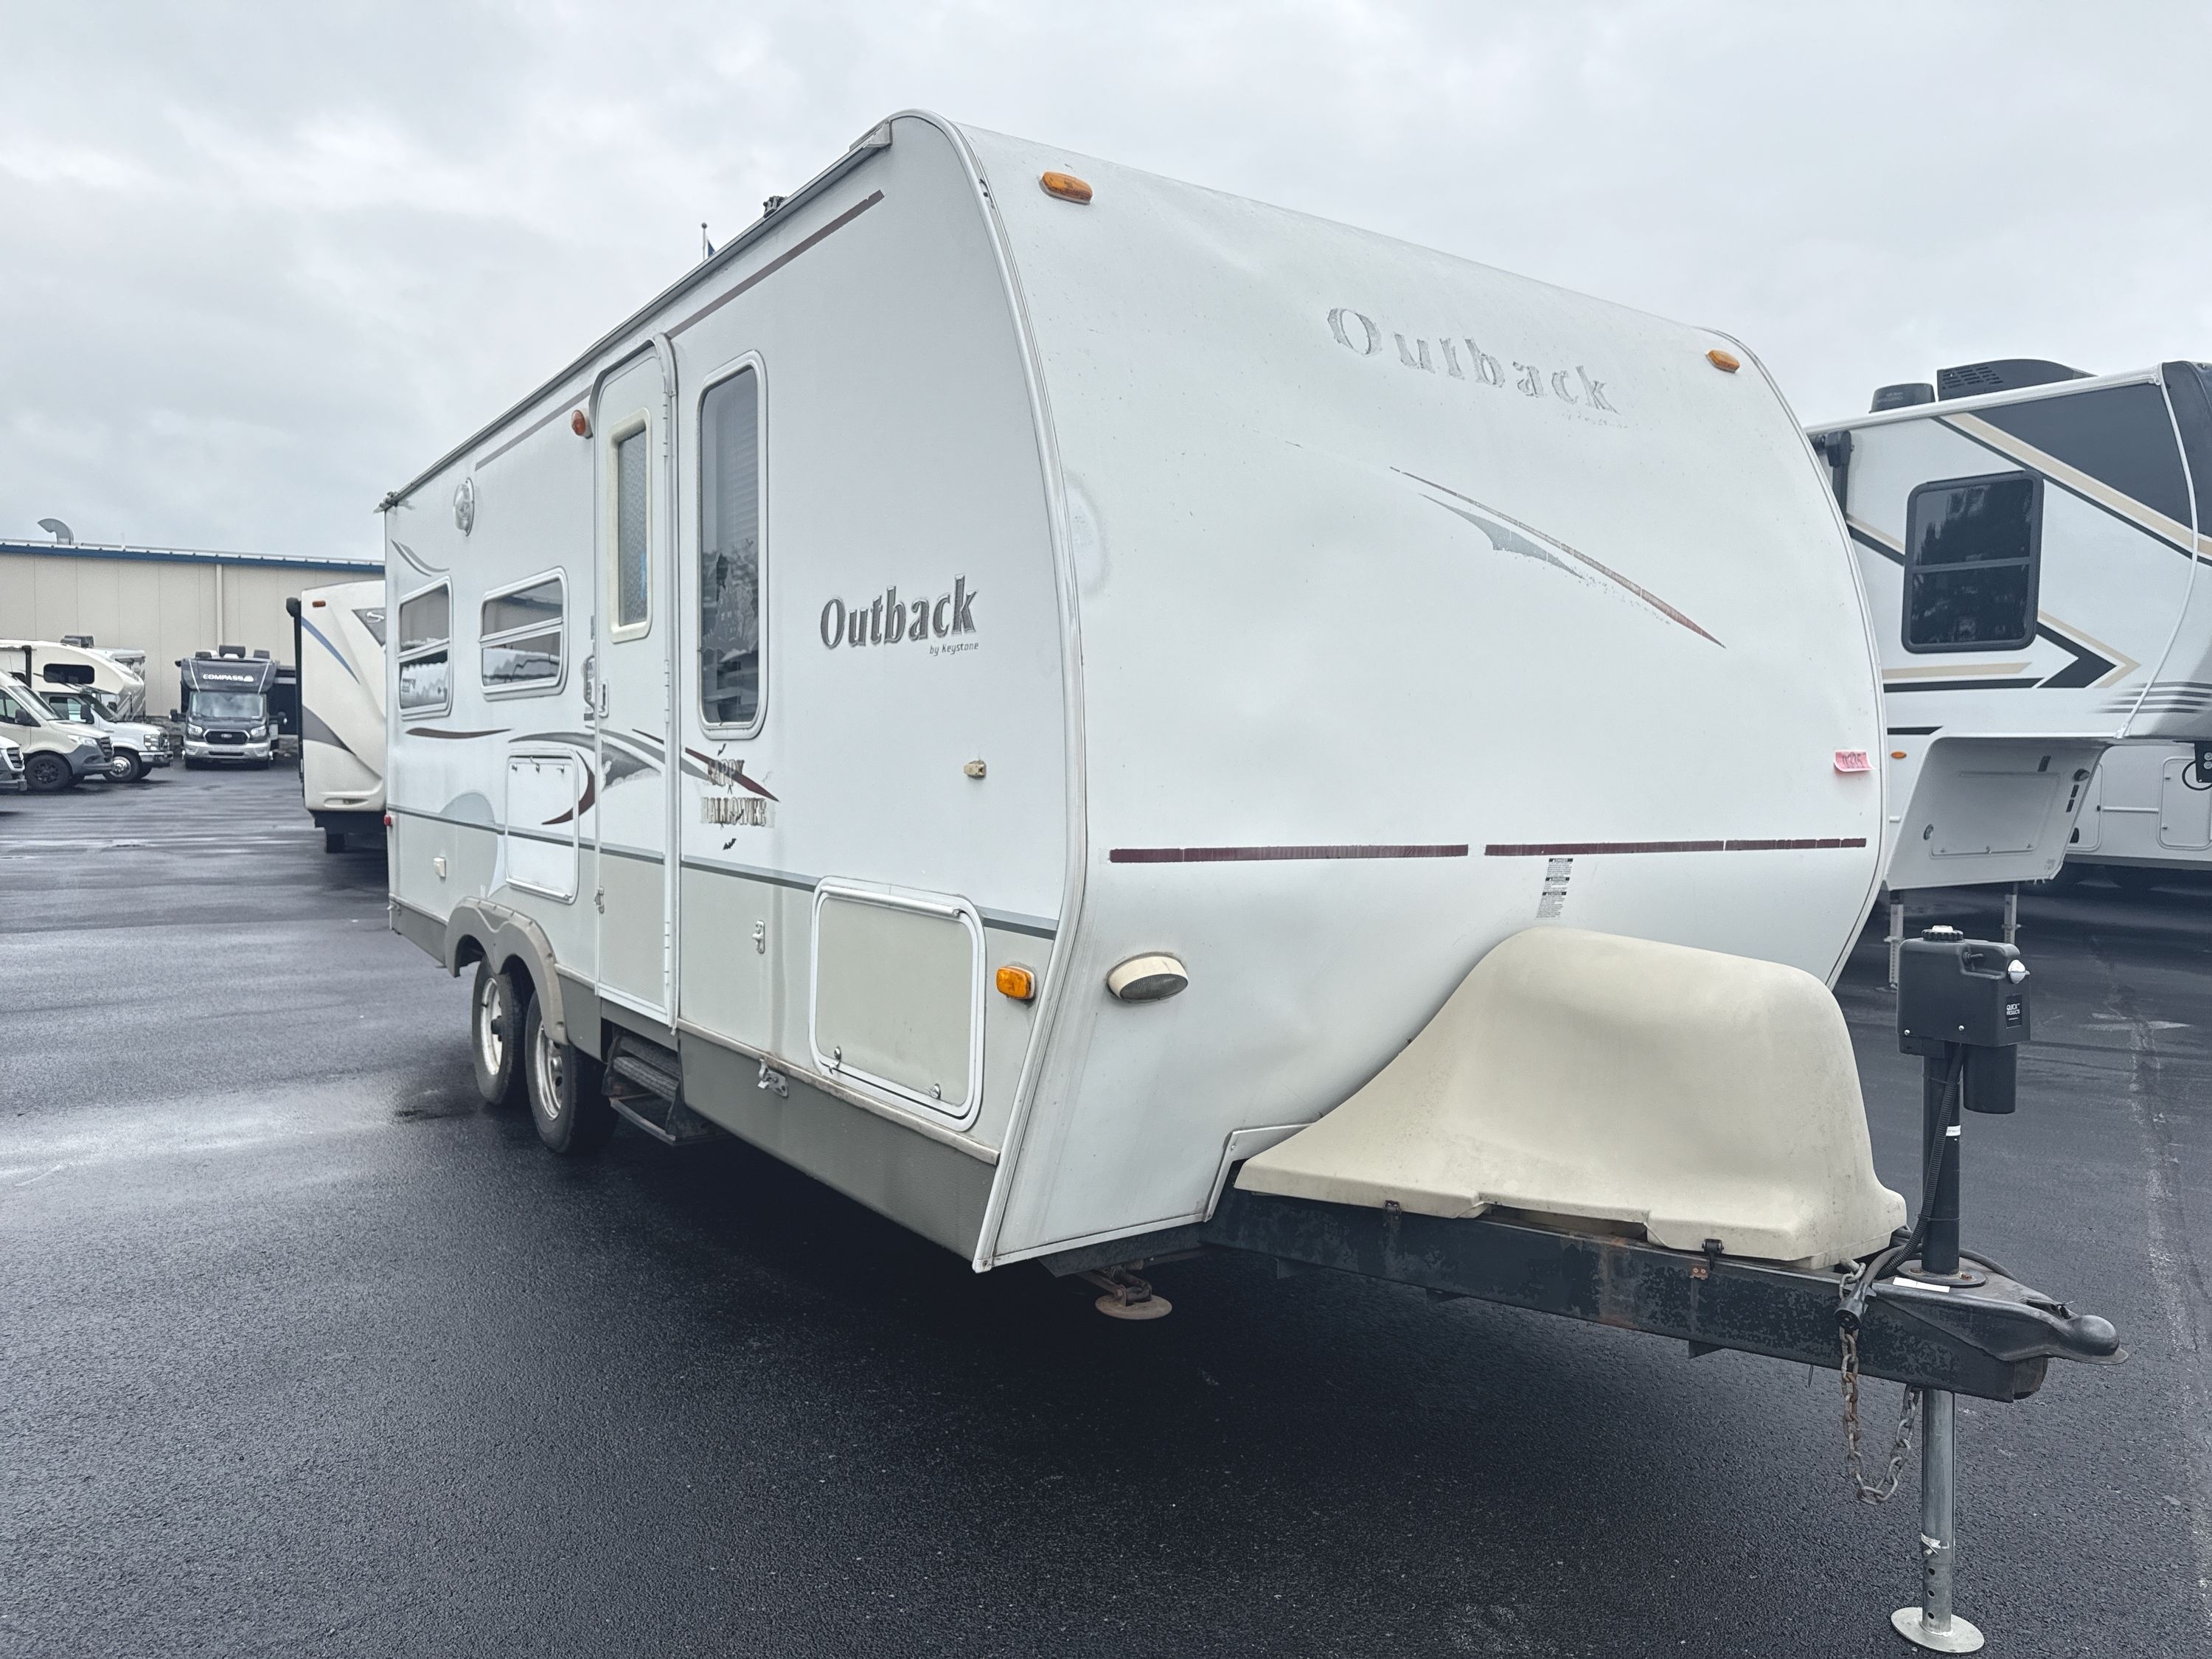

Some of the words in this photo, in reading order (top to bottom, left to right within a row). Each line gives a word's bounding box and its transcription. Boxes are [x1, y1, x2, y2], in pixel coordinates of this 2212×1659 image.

[1327, 307, 1621, 415] Outback
[820, 573, 978, 650] Outback
[929, 645, 939, 657] by
[942, 642, 979, 655] Keystone
[203, 673, 244, 681] COMPASS
